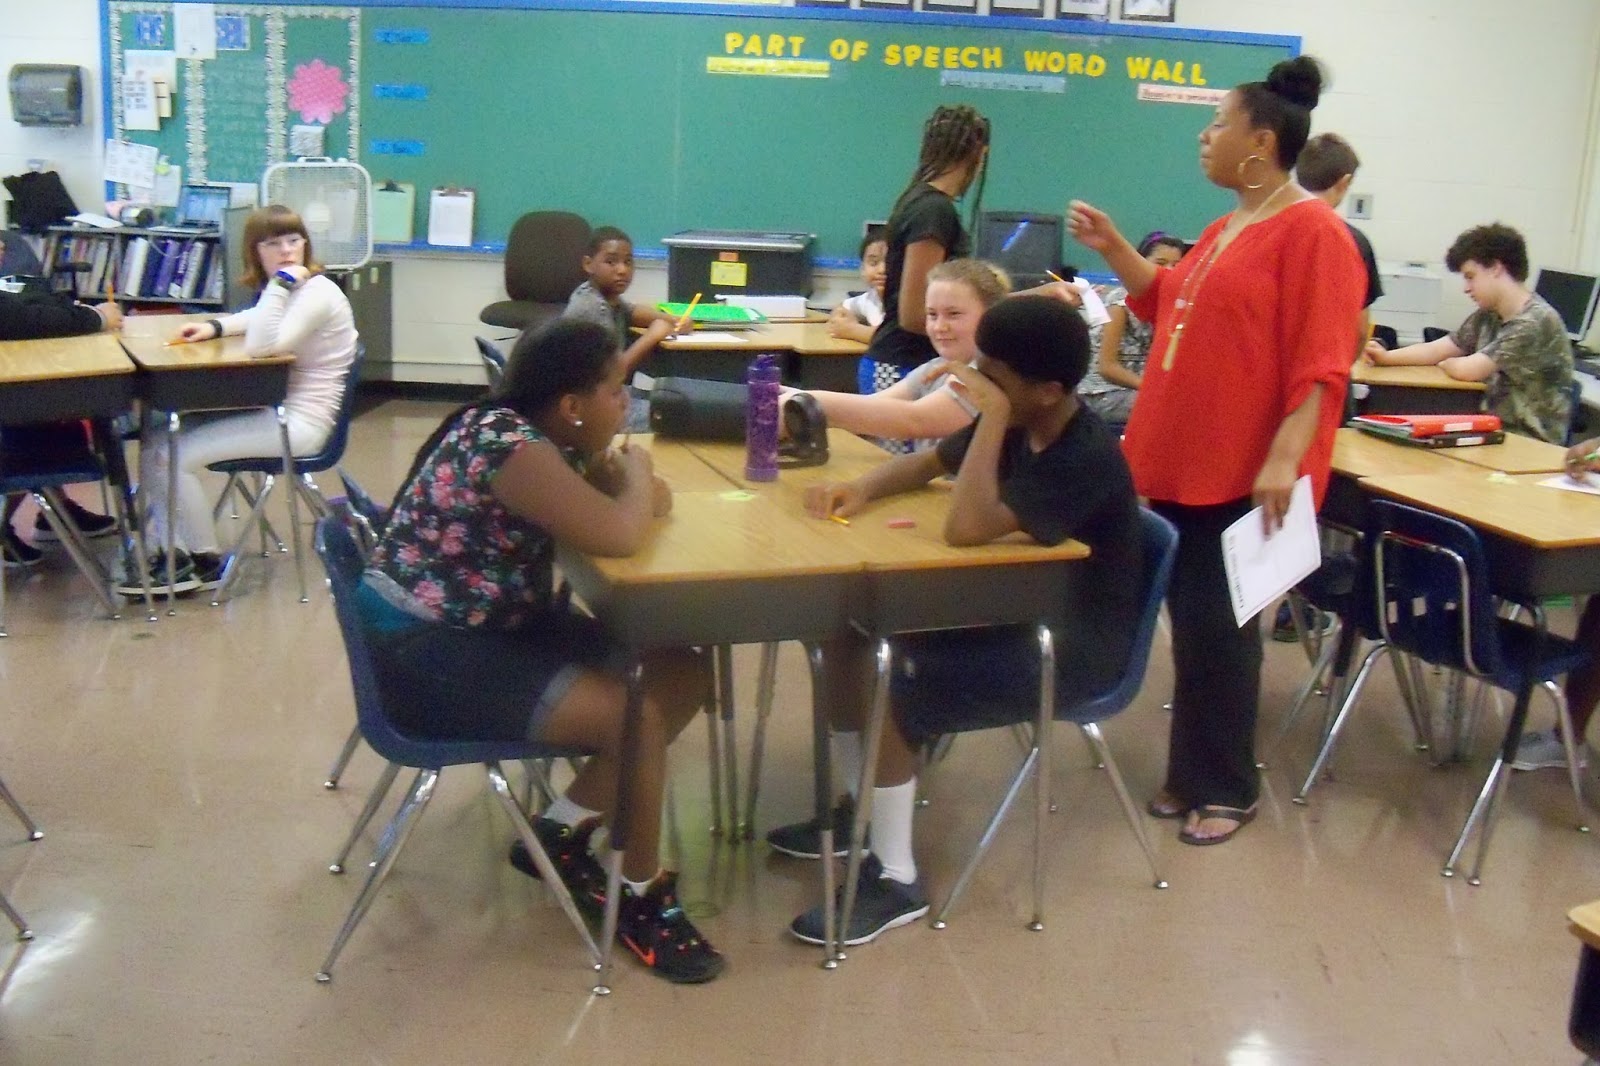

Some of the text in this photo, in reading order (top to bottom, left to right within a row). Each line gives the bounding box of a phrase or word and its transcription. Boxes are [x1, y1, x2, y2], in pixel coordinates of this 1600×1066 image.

[726, 32, 1207, 86] PART OF SPEECH WORD WALL
